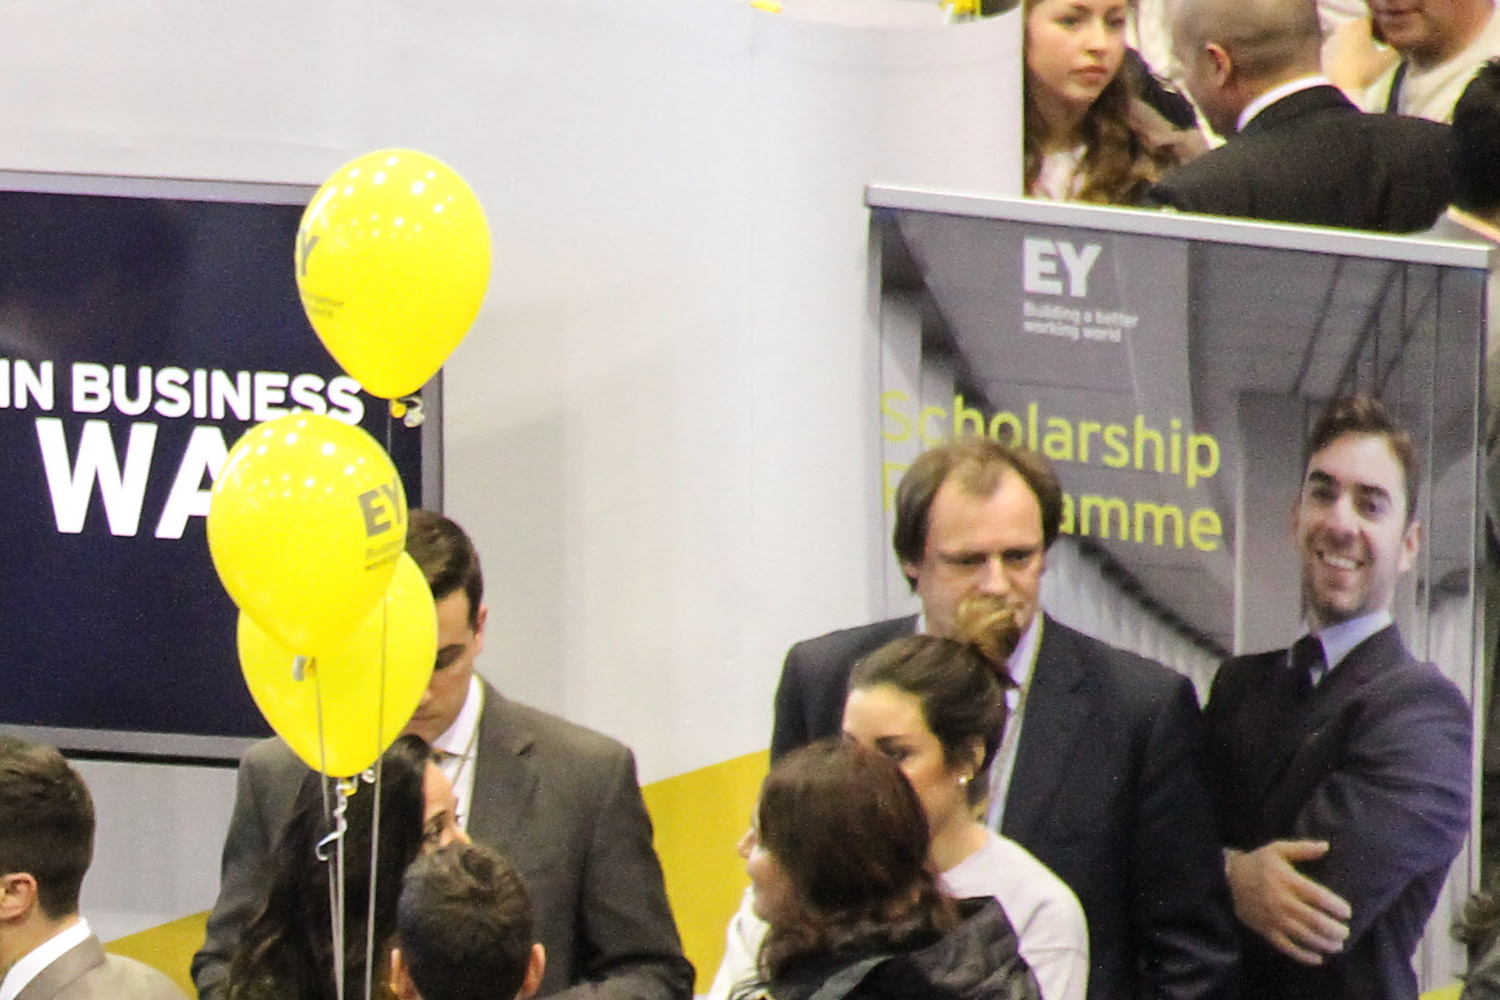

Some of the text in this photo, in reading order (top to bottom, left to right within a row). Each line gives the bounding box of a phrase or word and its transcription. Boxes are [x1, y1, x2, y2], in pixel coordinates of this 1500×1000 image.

[1023, 237, 1102, 298] EY
[72, 362, 365, 426] BUSINESS
[880, 389, 1221, 488] Scholarship
[35, 416, 248, 540] WA
[358, 475, 403, 537] EY
